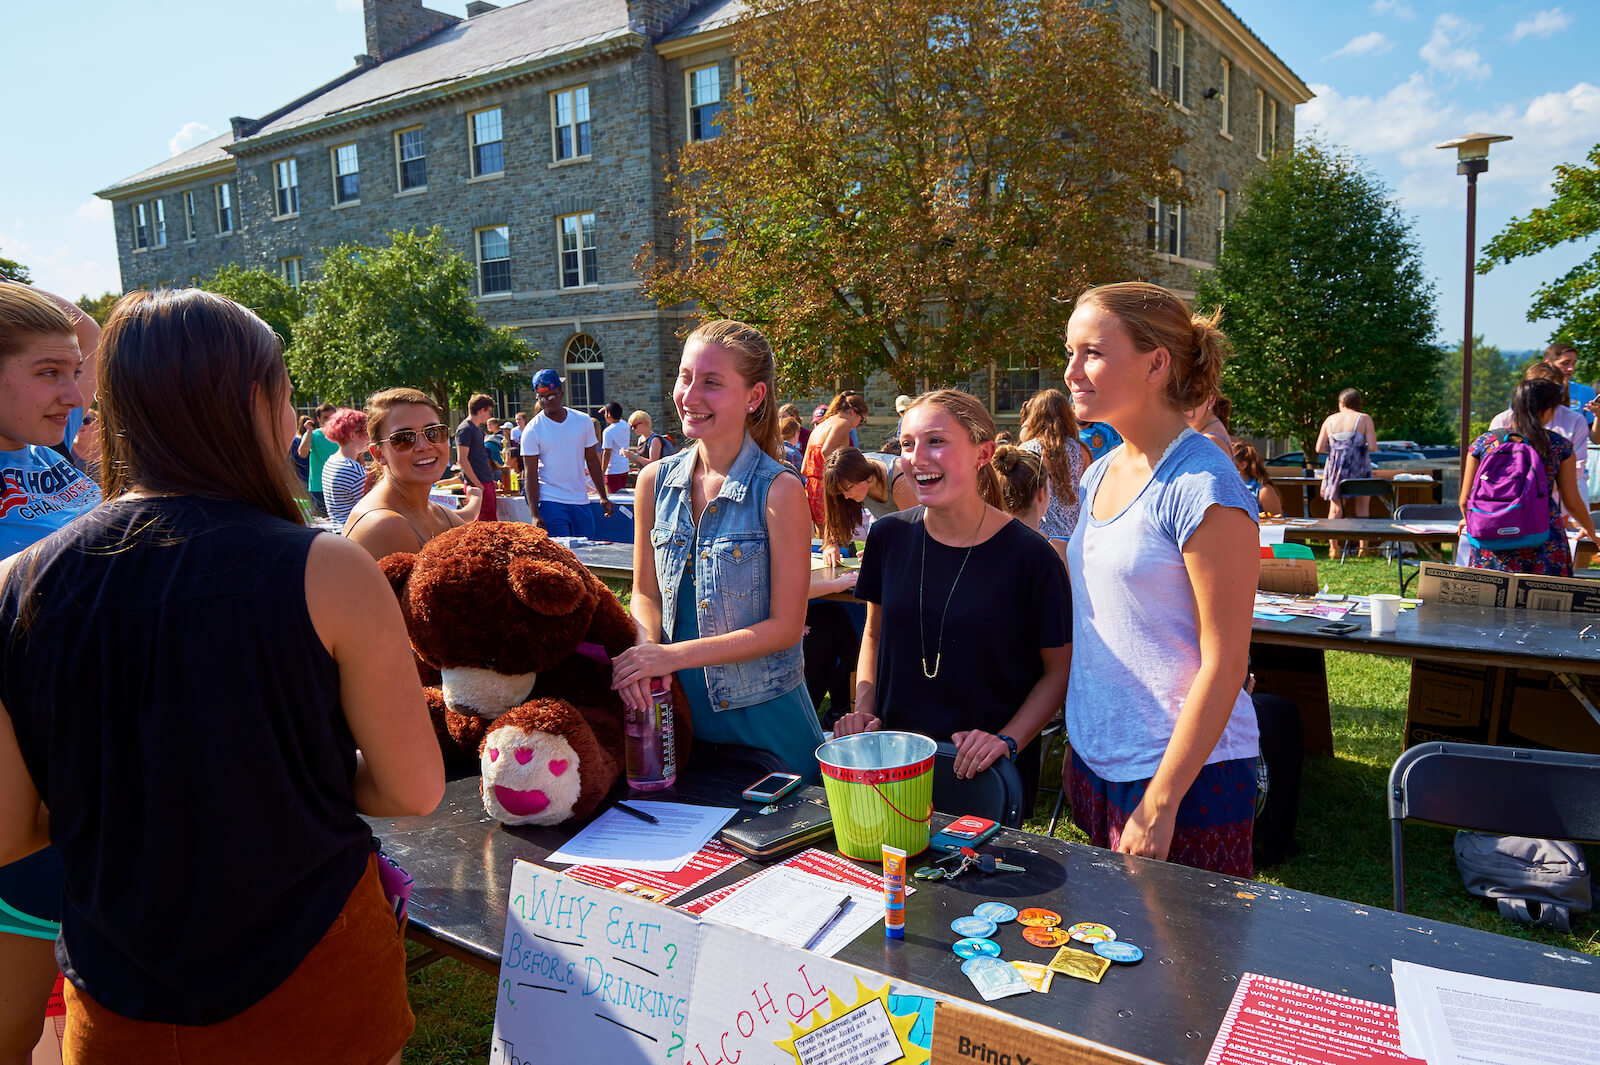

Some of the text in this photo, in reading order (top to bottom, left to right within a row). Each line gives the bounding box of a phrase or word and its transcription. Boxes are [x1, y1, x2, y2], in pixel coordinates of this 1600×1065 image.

[529, 874, 597, 939] WHY
[606, 906, 661, 954] EAT
[505, 932, 686, 1026] BEFORE DRINKING
[686, 964, 827, 1065] LCOHOL
[1250, 990, 1279, 1001] while
[1281, 997, 1338, 1016] improving
[1340, 1011, 1385, 1027] campus
[1254, 982, 1310, 999] Interested
[1325, 998, 1380, 1017] becoming
[1257, 1001, 1276, 1010] Get
[1285, 1008, 1336, 1024] jumpstart
[1354, 1025, 1379, 1034] your
[1243, 1007, 1274, 1019] Apply
[1288, 1017, 1301, 1026] be
[1313, 1023, 1336, 1034] Peer
[1338, 1030, 1374, 1044] Health
[1278, 1023, 1298, 1032] Peer
[1299, 1029, 1327, 1040] Health
[1328, 1036, 1367, 1050] Educator
[1369, 1046, 1385, 1054] You
[958, 1035, 1012, 1065] Bring
[1228, 1043, 1255, 1053] APPLY
